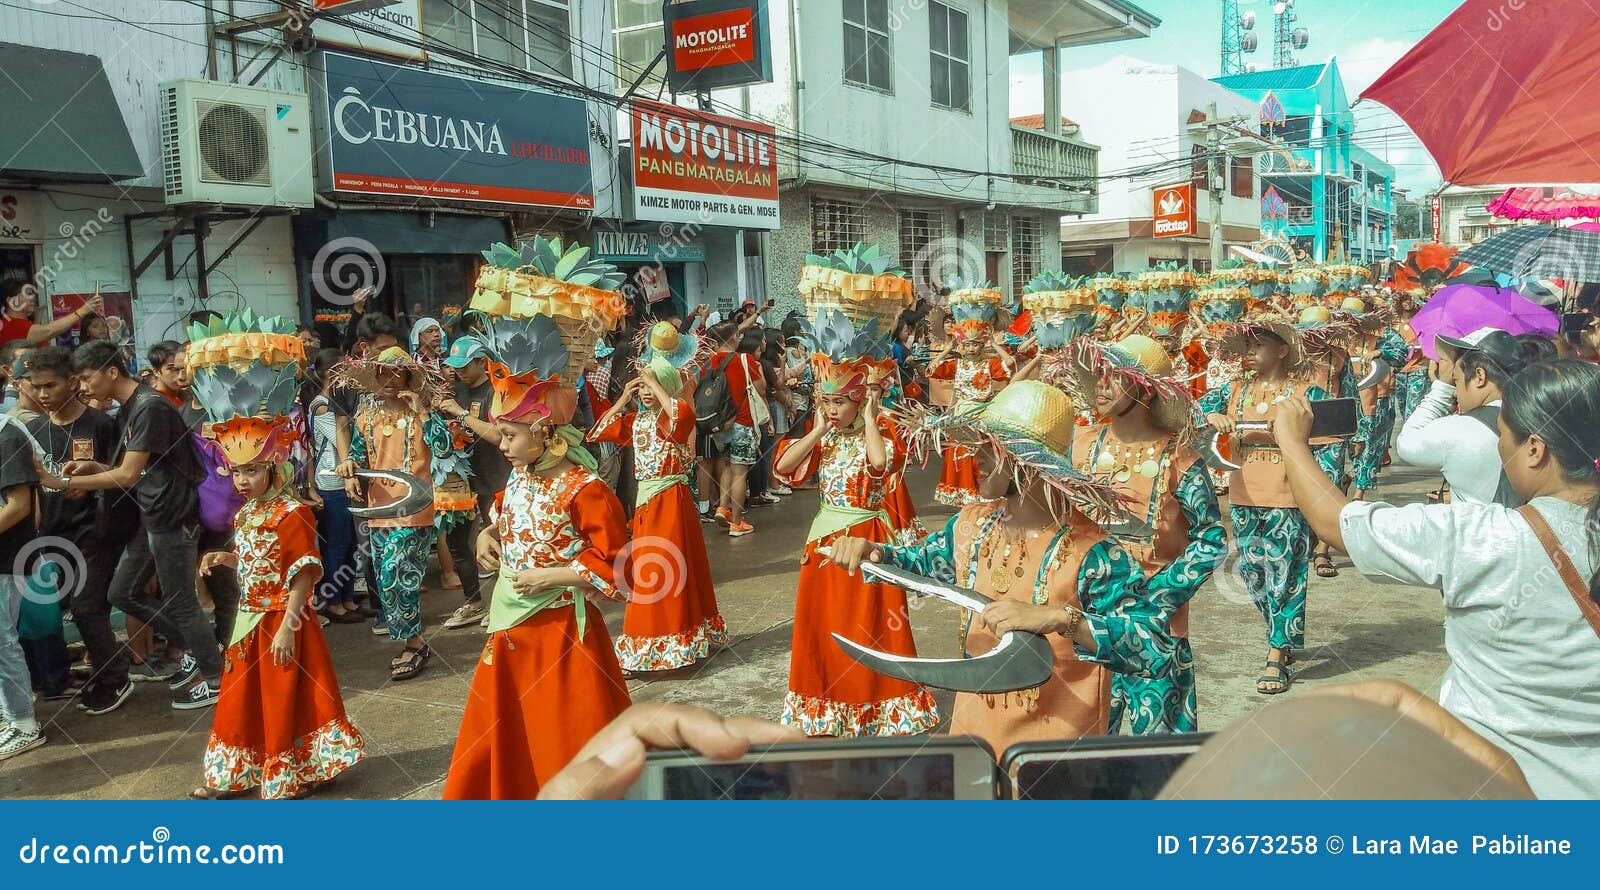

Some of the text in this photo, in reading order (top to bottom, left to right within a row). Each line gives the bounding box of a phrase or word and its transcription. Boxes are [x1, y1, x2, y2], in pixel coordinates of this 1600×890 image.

[676, 24, 747, 48] MOTOLITE
[688, 43, 736, 54] PANGMATAGALAN
[640, 112, 771, 167] MOTOLITE
[511, 140, 589, 166] LHUILLIER
[639, 157, 771, 187] PANGMATAGALAN
[640, 195, 777, 217] KIMZE MOTOR PARTS & GEN. MDSE
[596, 231, 649, 256] KIMZE
